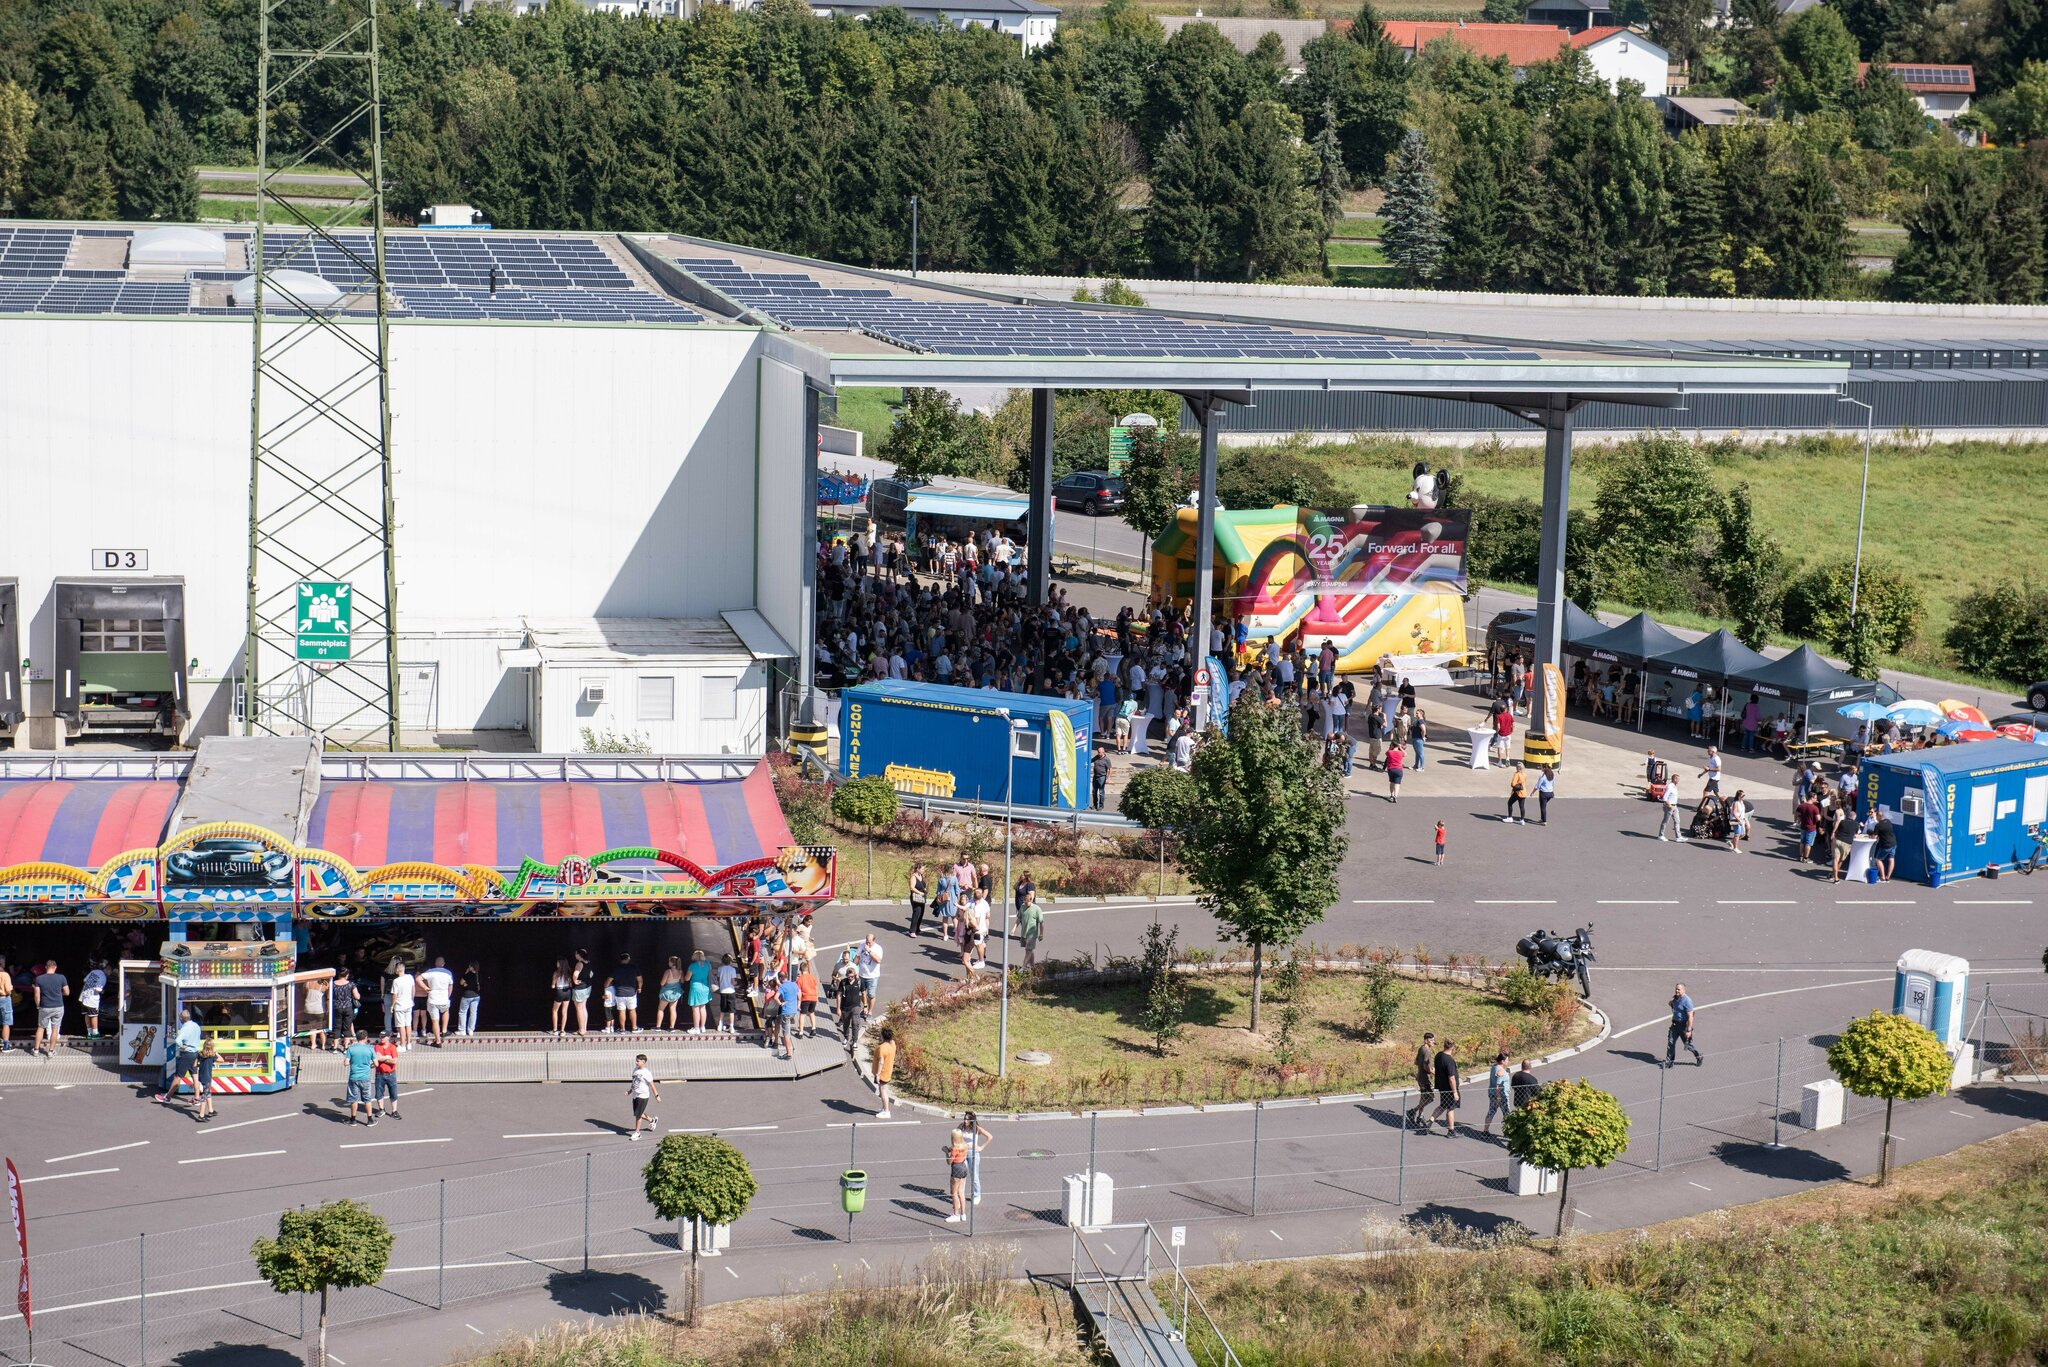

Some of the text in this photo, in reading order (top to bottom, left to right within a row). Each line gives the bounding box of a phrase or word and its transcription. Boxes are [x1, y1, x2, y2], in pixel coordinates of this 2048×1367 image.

[1308, 533, 1345, 559] 25
[1368, 542, 1457, 554] Forward. For all.
[105, 551, 136, 568] D 3
[300, 639, 347, 648] Sammelplatz
[318, 647, 327, 655] 01
[880, 696, 1000, 716] www.containex.co
[849, 703, 862, 779] CONTAINEX
[568, 885, 699, 896] GRAND PRIX
[719, 878, 757, 897] R
[1174, 1231, 1183, 1242] S
